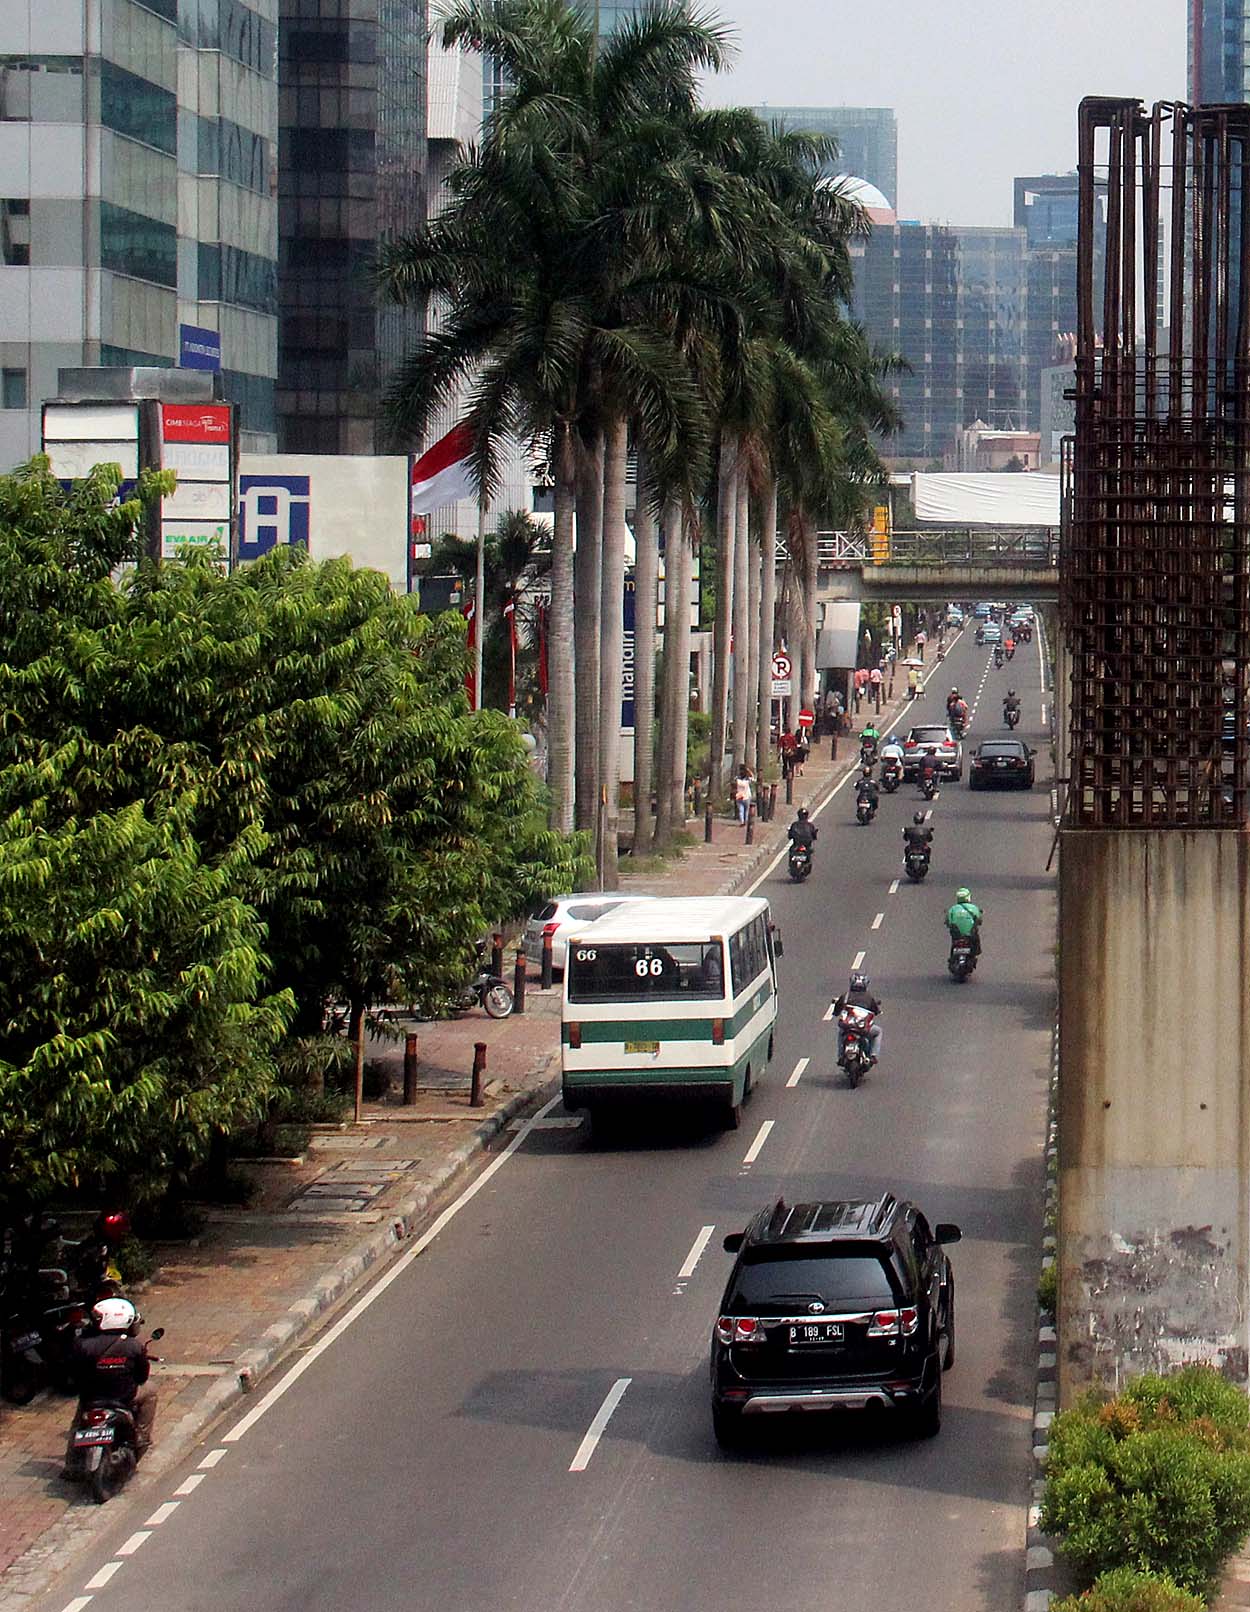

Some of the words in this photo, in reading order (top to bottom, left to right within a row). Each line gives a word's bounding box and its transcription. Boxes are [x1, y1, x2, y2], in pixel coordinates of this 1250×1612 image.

[576, 949, 598, 961] 66
[635, 958, 664, 976] 66
[790, 1327, 797, 1338] B
[803, 1326, 819, 1337] 189
[826, 1324, 843, 1336] FSL
